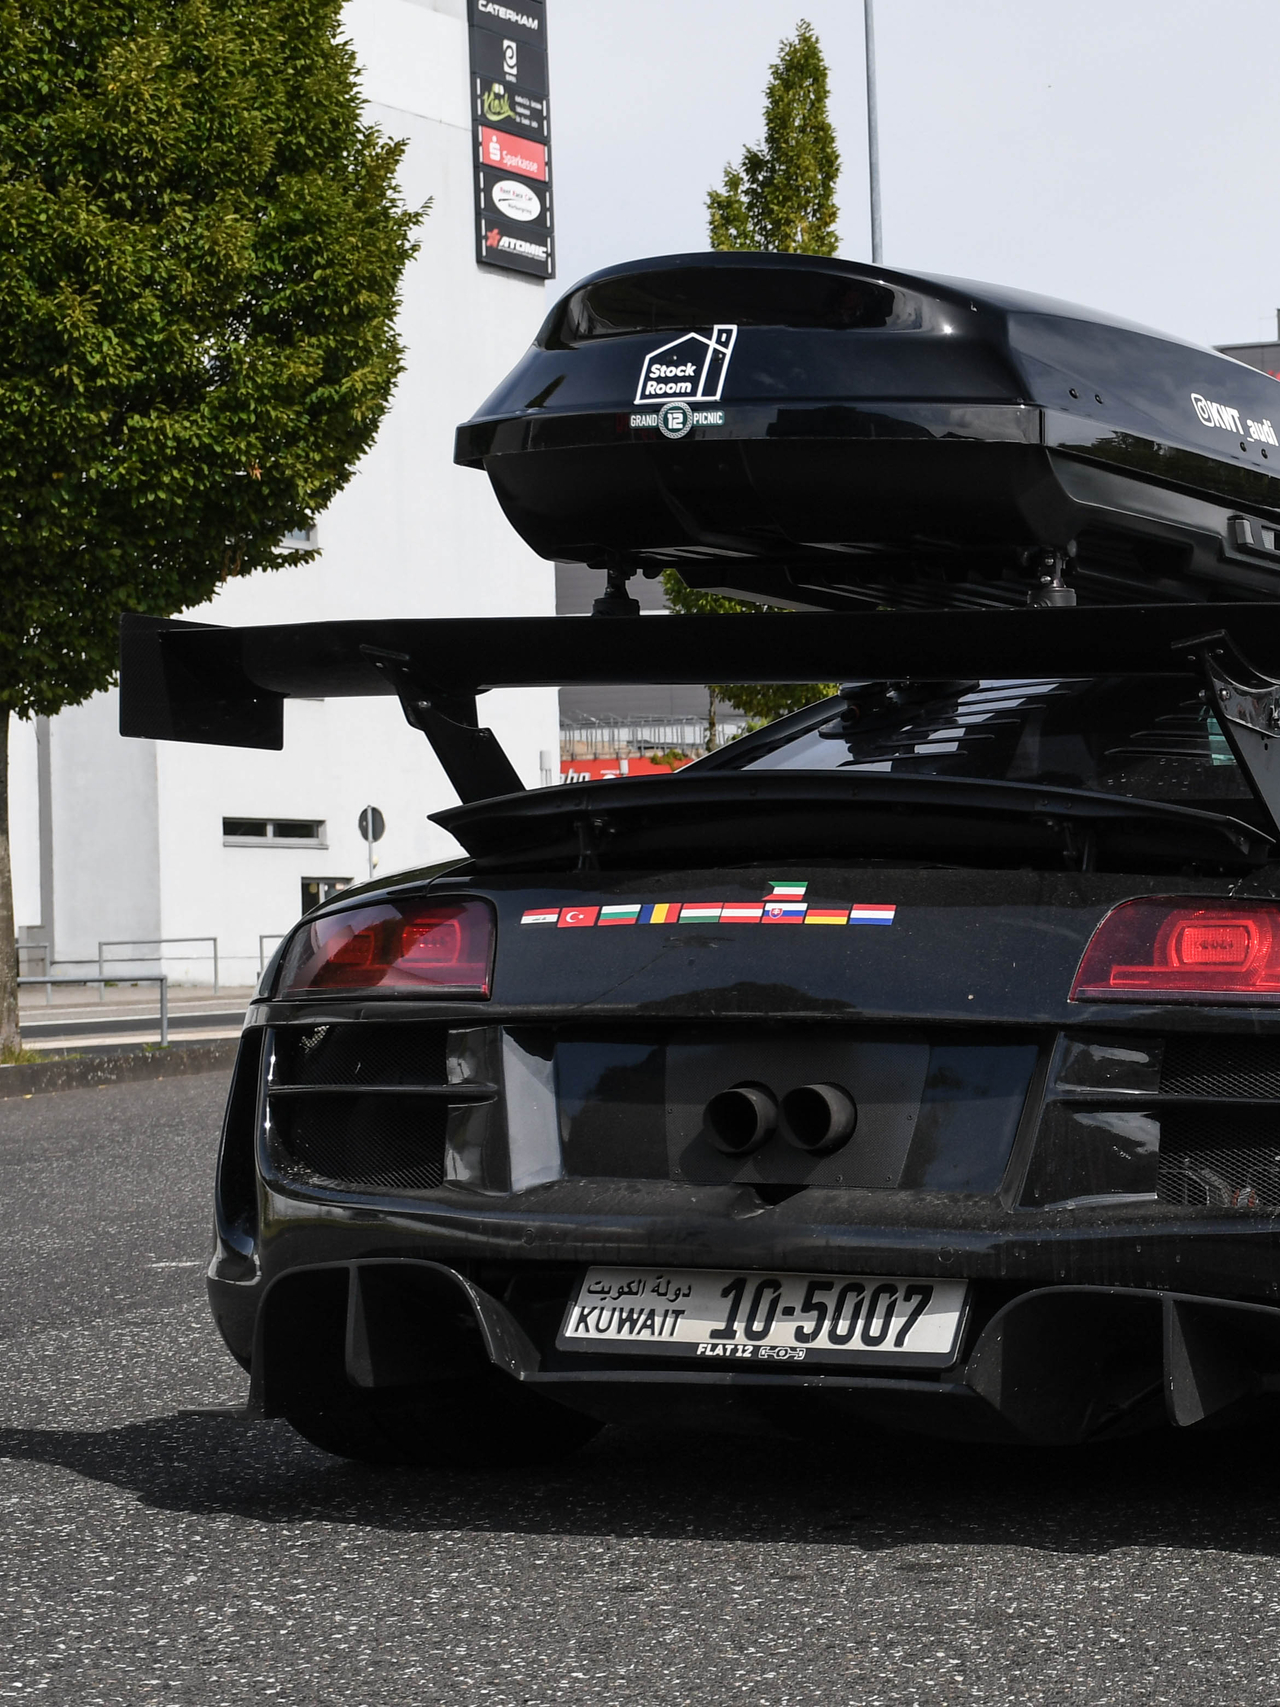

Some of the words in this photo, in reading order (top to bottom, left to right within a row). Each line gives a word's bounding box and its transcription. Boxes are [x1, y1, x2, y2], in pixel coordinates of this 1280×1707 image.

[478, 0, 539, 30] CATERHAM
[502, 150, 538, 173] Sparkasse
[499, 235, 547, 257] ATOMIC
[649, 363, 696, 378] Stock
[645, 381, 692, 395] Room
[630, 414, 657, 427] GRAND
[693, 411, 723, 425] PICNIC
[587, 1278, 646, 1301] الكويت
[650, 1275, 692, 1303] دولة
[574, 1305, 686, 1337] KUWAIT
[709, 1276, 934, 1348] 10-5007
[696, 1343, 733, 1356] FLAT
[735, 1345, 753, 1357] 12
